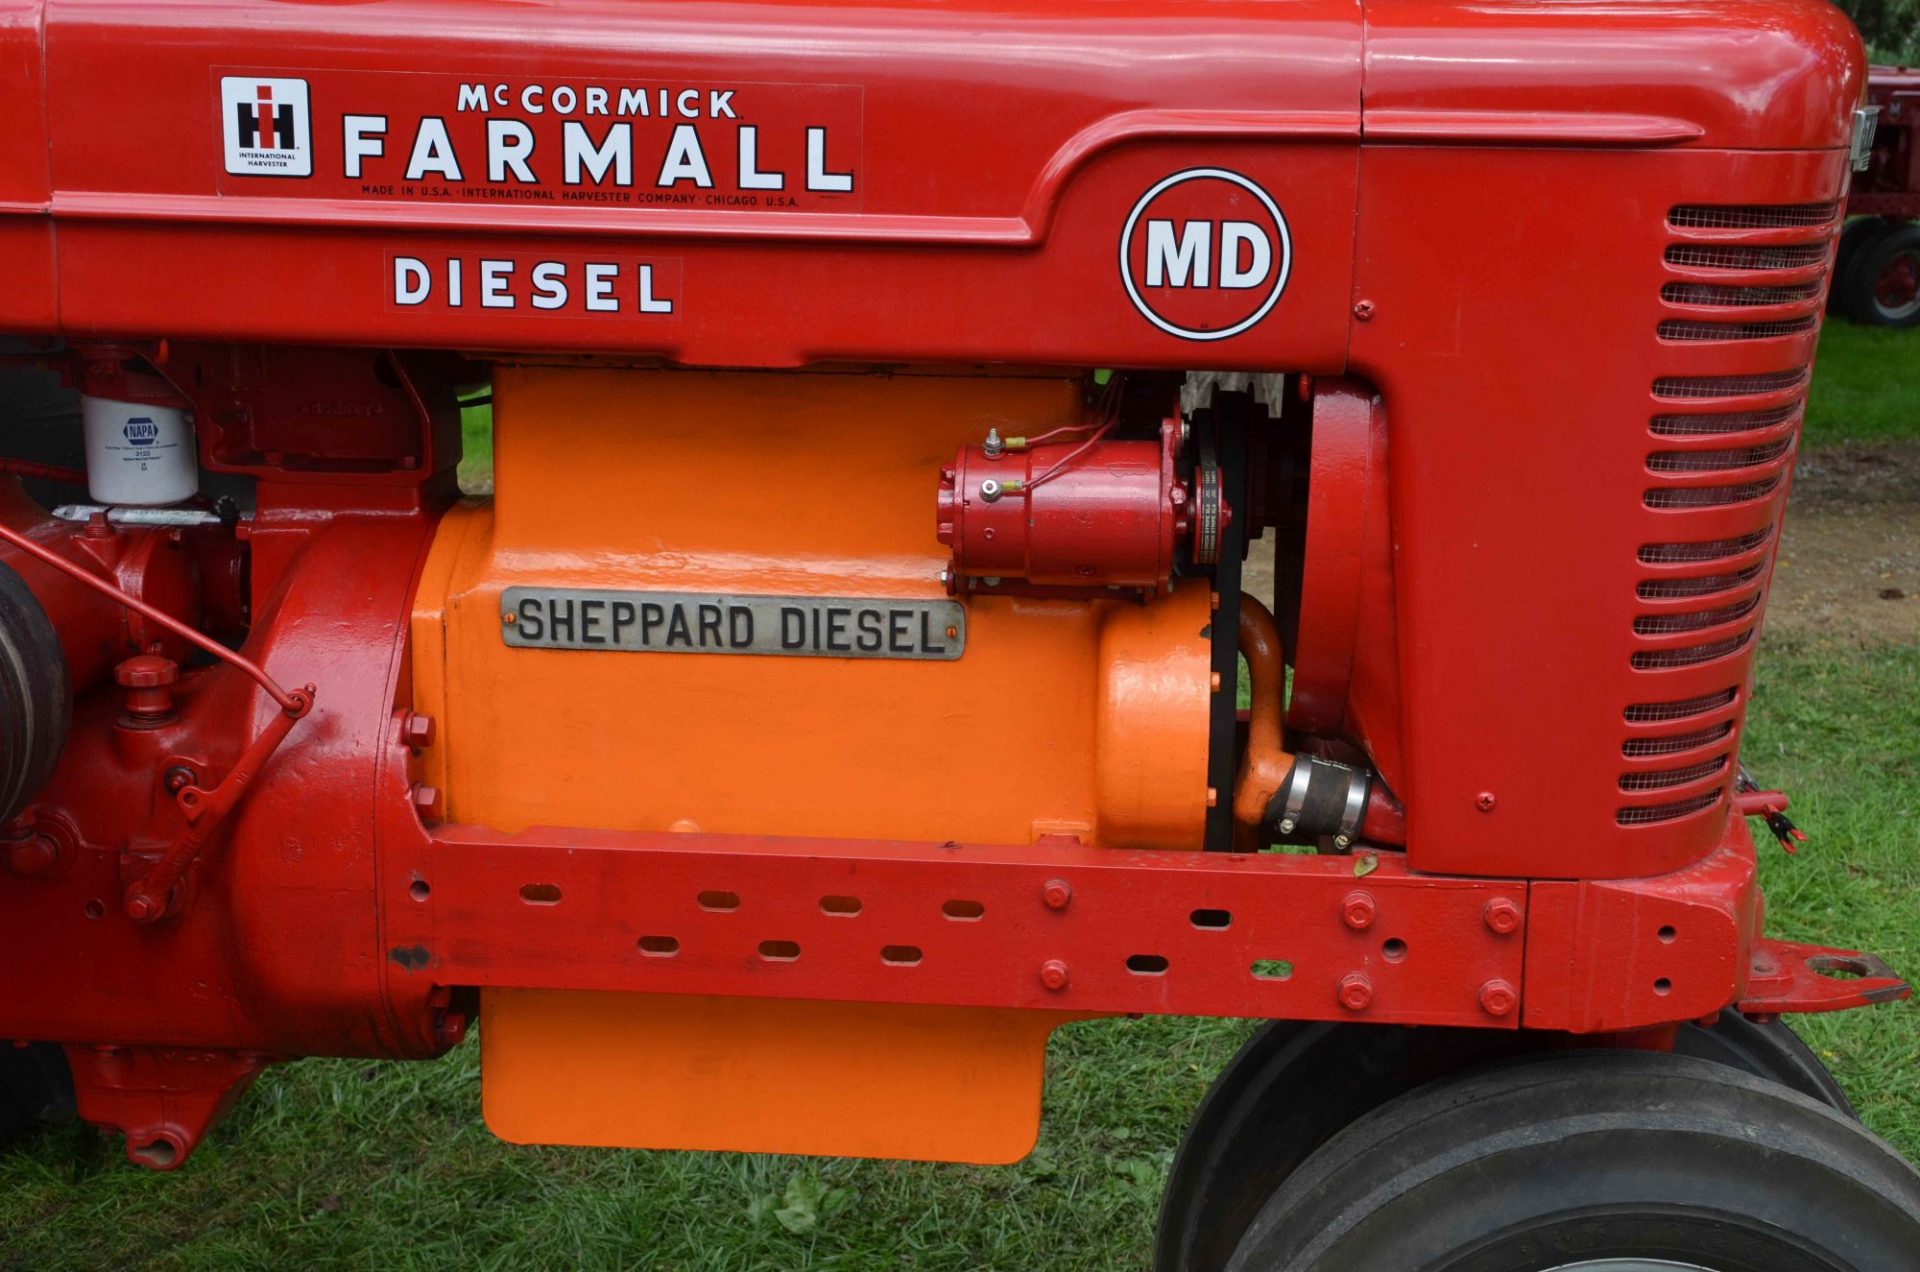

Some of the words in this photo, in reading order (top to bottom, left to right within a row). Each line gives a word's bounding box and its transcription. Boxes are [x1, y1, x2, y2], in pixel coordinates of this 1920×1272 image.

[239, 152, 296, 160] INTERNATIONAL
[247, 160, 288, 168] HARVESTER
[341, 113, 854, 193] FARMALL
[361, 185, 395, 195] MADE
[401, 186, 414, 195] IN
[420, 186, 452, 197] U.S.A.
[462, 187, 555, 200] INTERNATIONAL
[562, 191, 630, 203] HARVESTER
[637, 193, 696, 205] COMPANY
[706, 194, 757, 206] CHICAGO
[766, 196, 799, 207] U.S.A.
[1144, 218, 1273, 290] MD
[393, 256, 673, 314] DIESEL
[129, 424, 154, 438] NAPA
[517, 598, 755, 649] SHEPPARD
[780, 606, 946, 653] DIESEL
